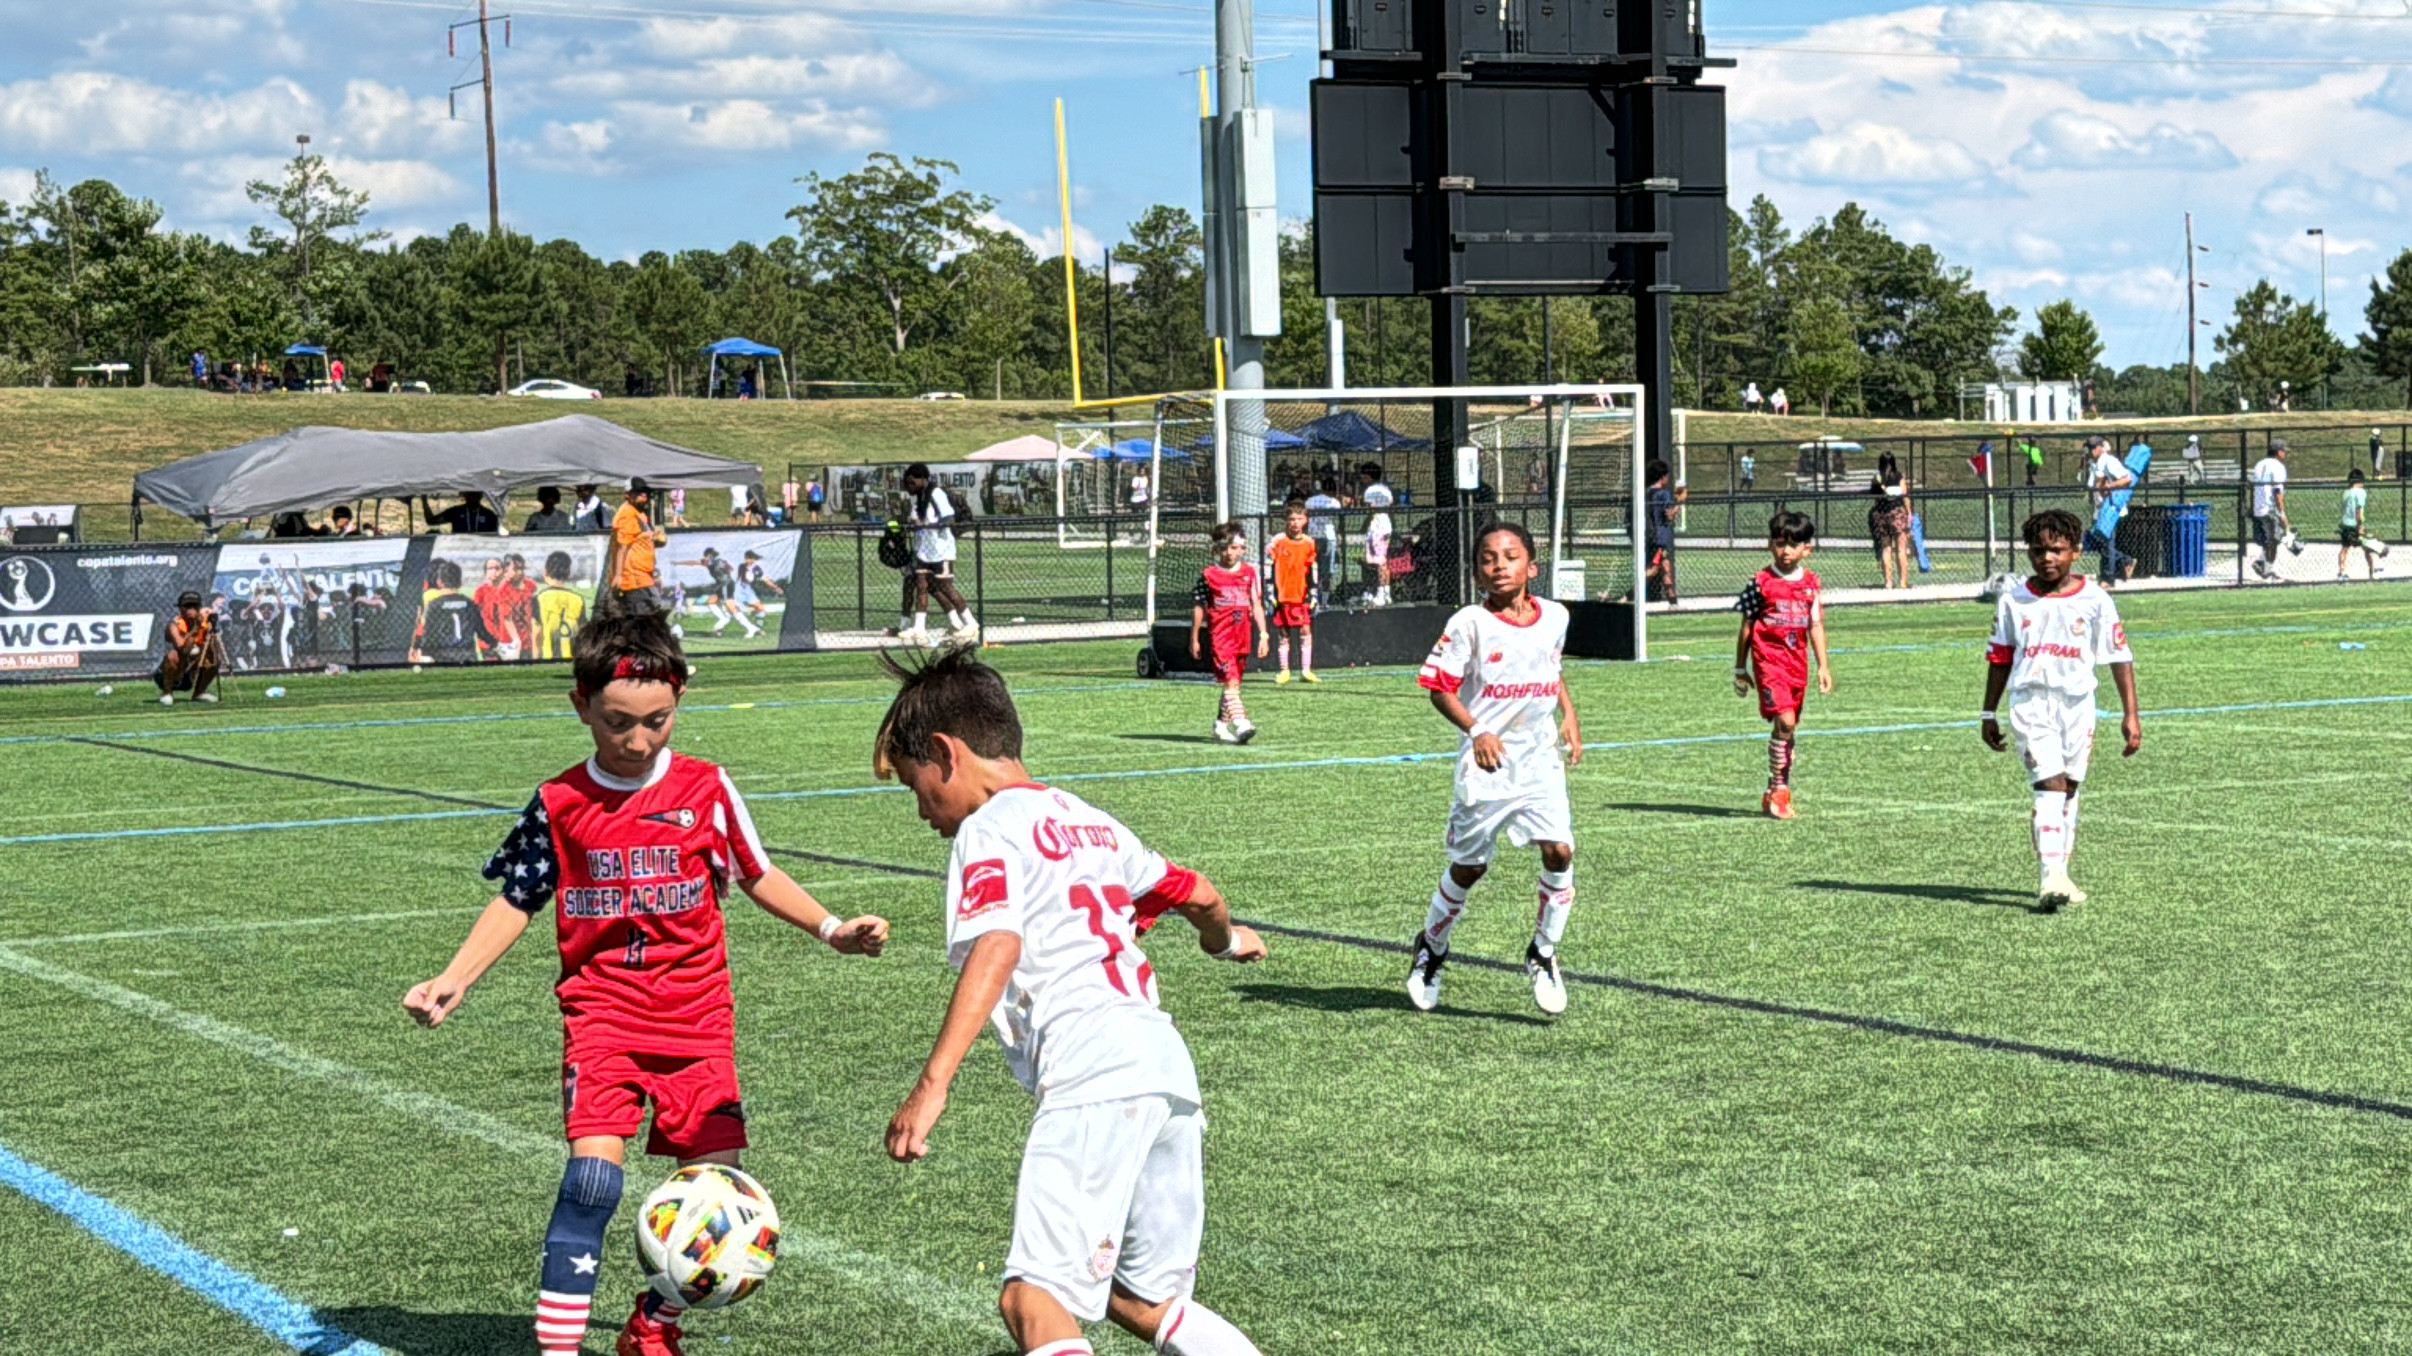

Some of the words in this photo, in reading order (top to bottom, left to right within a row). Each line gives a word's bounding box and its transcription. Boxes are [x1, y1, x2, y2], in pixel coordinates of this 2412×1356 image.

[76, 553, 178, 569] copatalento.org
[0, 621, 133, 647] WCASE
[587, 848, 625, 880] USA
[628, 845, 680, 878] ELITE
[564, 887, 624, 918] SOCCER
